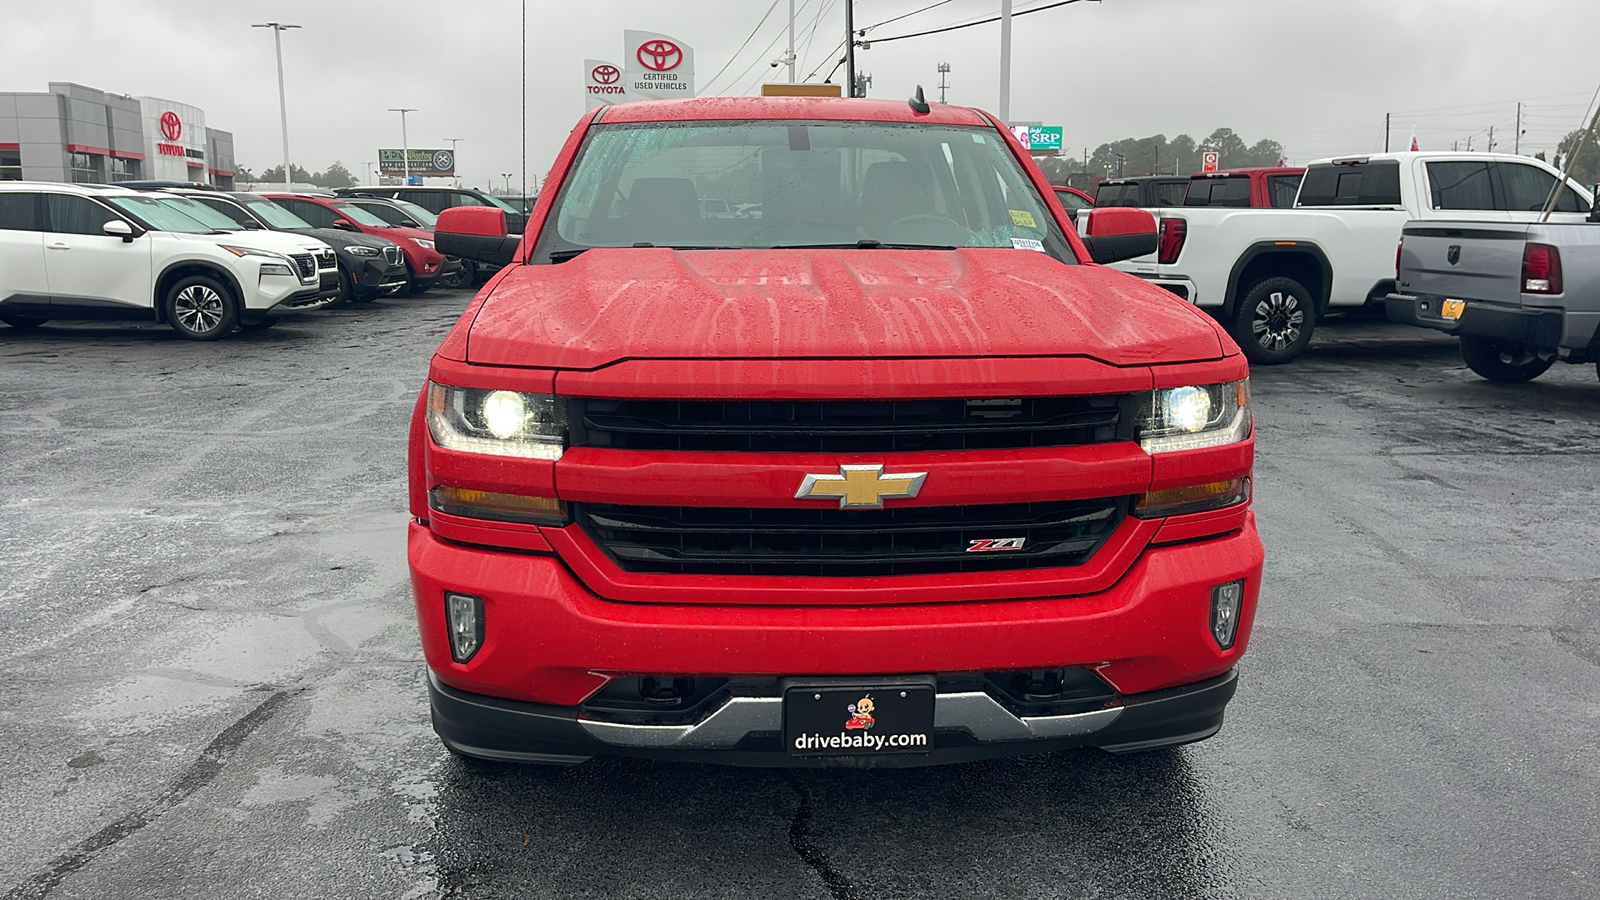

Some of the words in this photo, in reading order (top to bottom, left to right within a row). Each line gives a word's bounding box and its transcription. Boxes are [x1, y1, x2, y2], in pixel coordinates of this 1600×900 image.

[643, 73, 678, 81] CERTIFIED
[587, 85, 626, 95] TOYOTA
[634, 82, 653, 90] USED
[654, 82, 687, 90] VEHICLES
[1031, 133, 1060, 143] SRP
[157, 143, 185, 157] TOYOTA
[966, 537, 1026, 552] Z71
[795, 731, 927, 750] drivebaby.com
